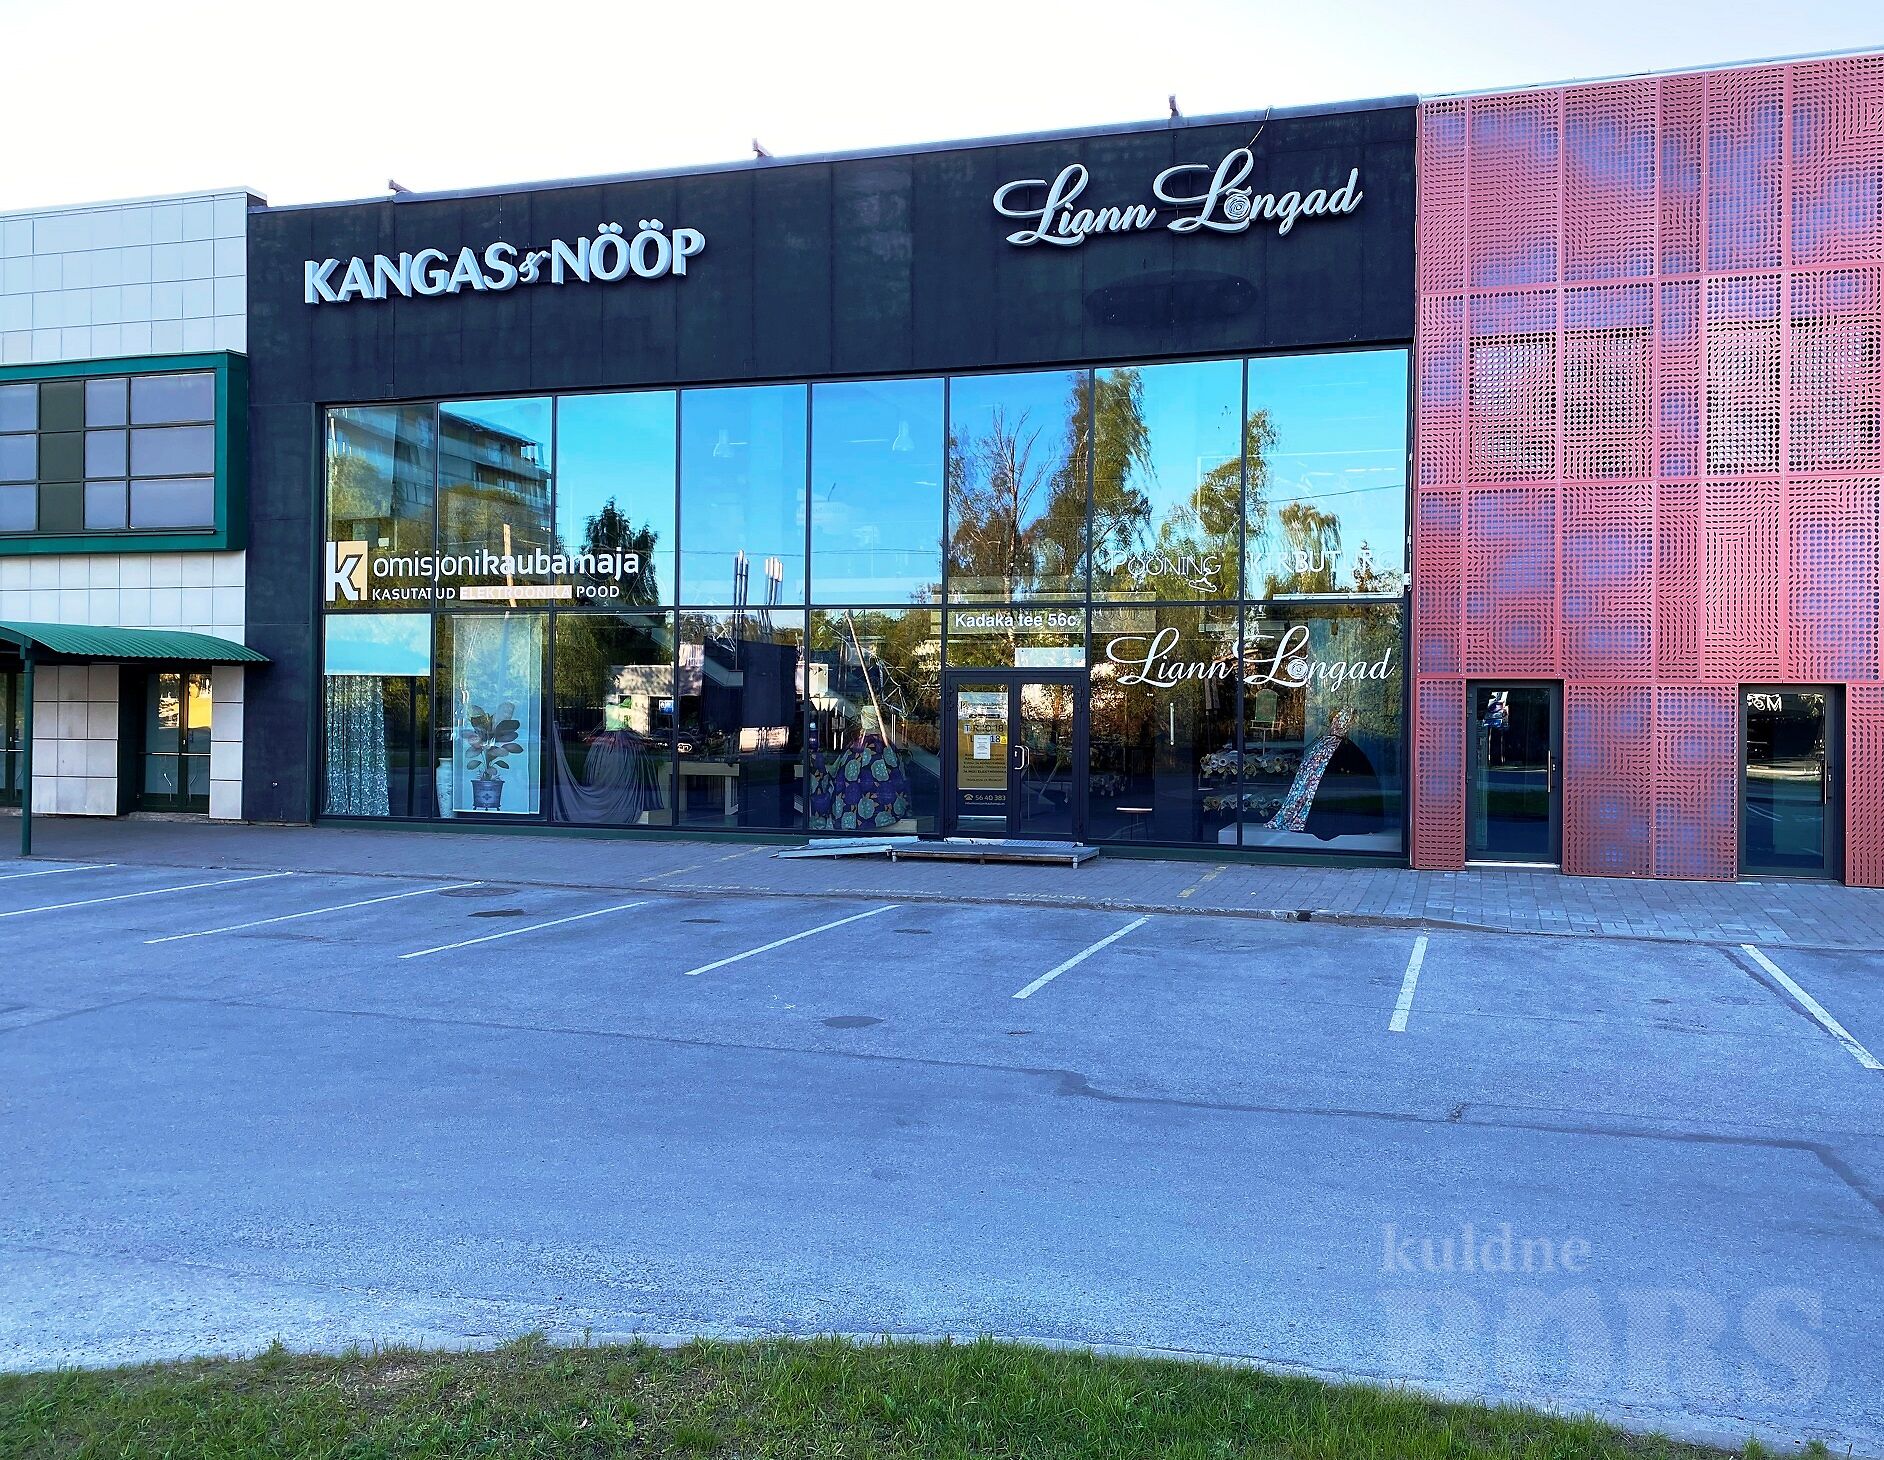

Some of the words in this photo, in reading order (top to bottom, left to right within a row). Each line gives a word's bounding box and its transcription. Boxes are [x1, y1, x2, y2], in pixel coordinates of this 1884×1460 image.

[993, 164, 1157, 246] Liann
[304, 241, 518, 304] KANGAS
[519, 249, 551, 284] &
[551, 218, 706, 285] NÖÖP
[460, 586, 572, 600] ELEKTROONIKA
[576, 585, 620, 598] POOD
[955, 613, 1014, 628] Kadaka
[1018, 614, 1043, 628] tee
[1047, 613, 1077, 627] 56c
[1106, 627, 1236, 687] Liann
